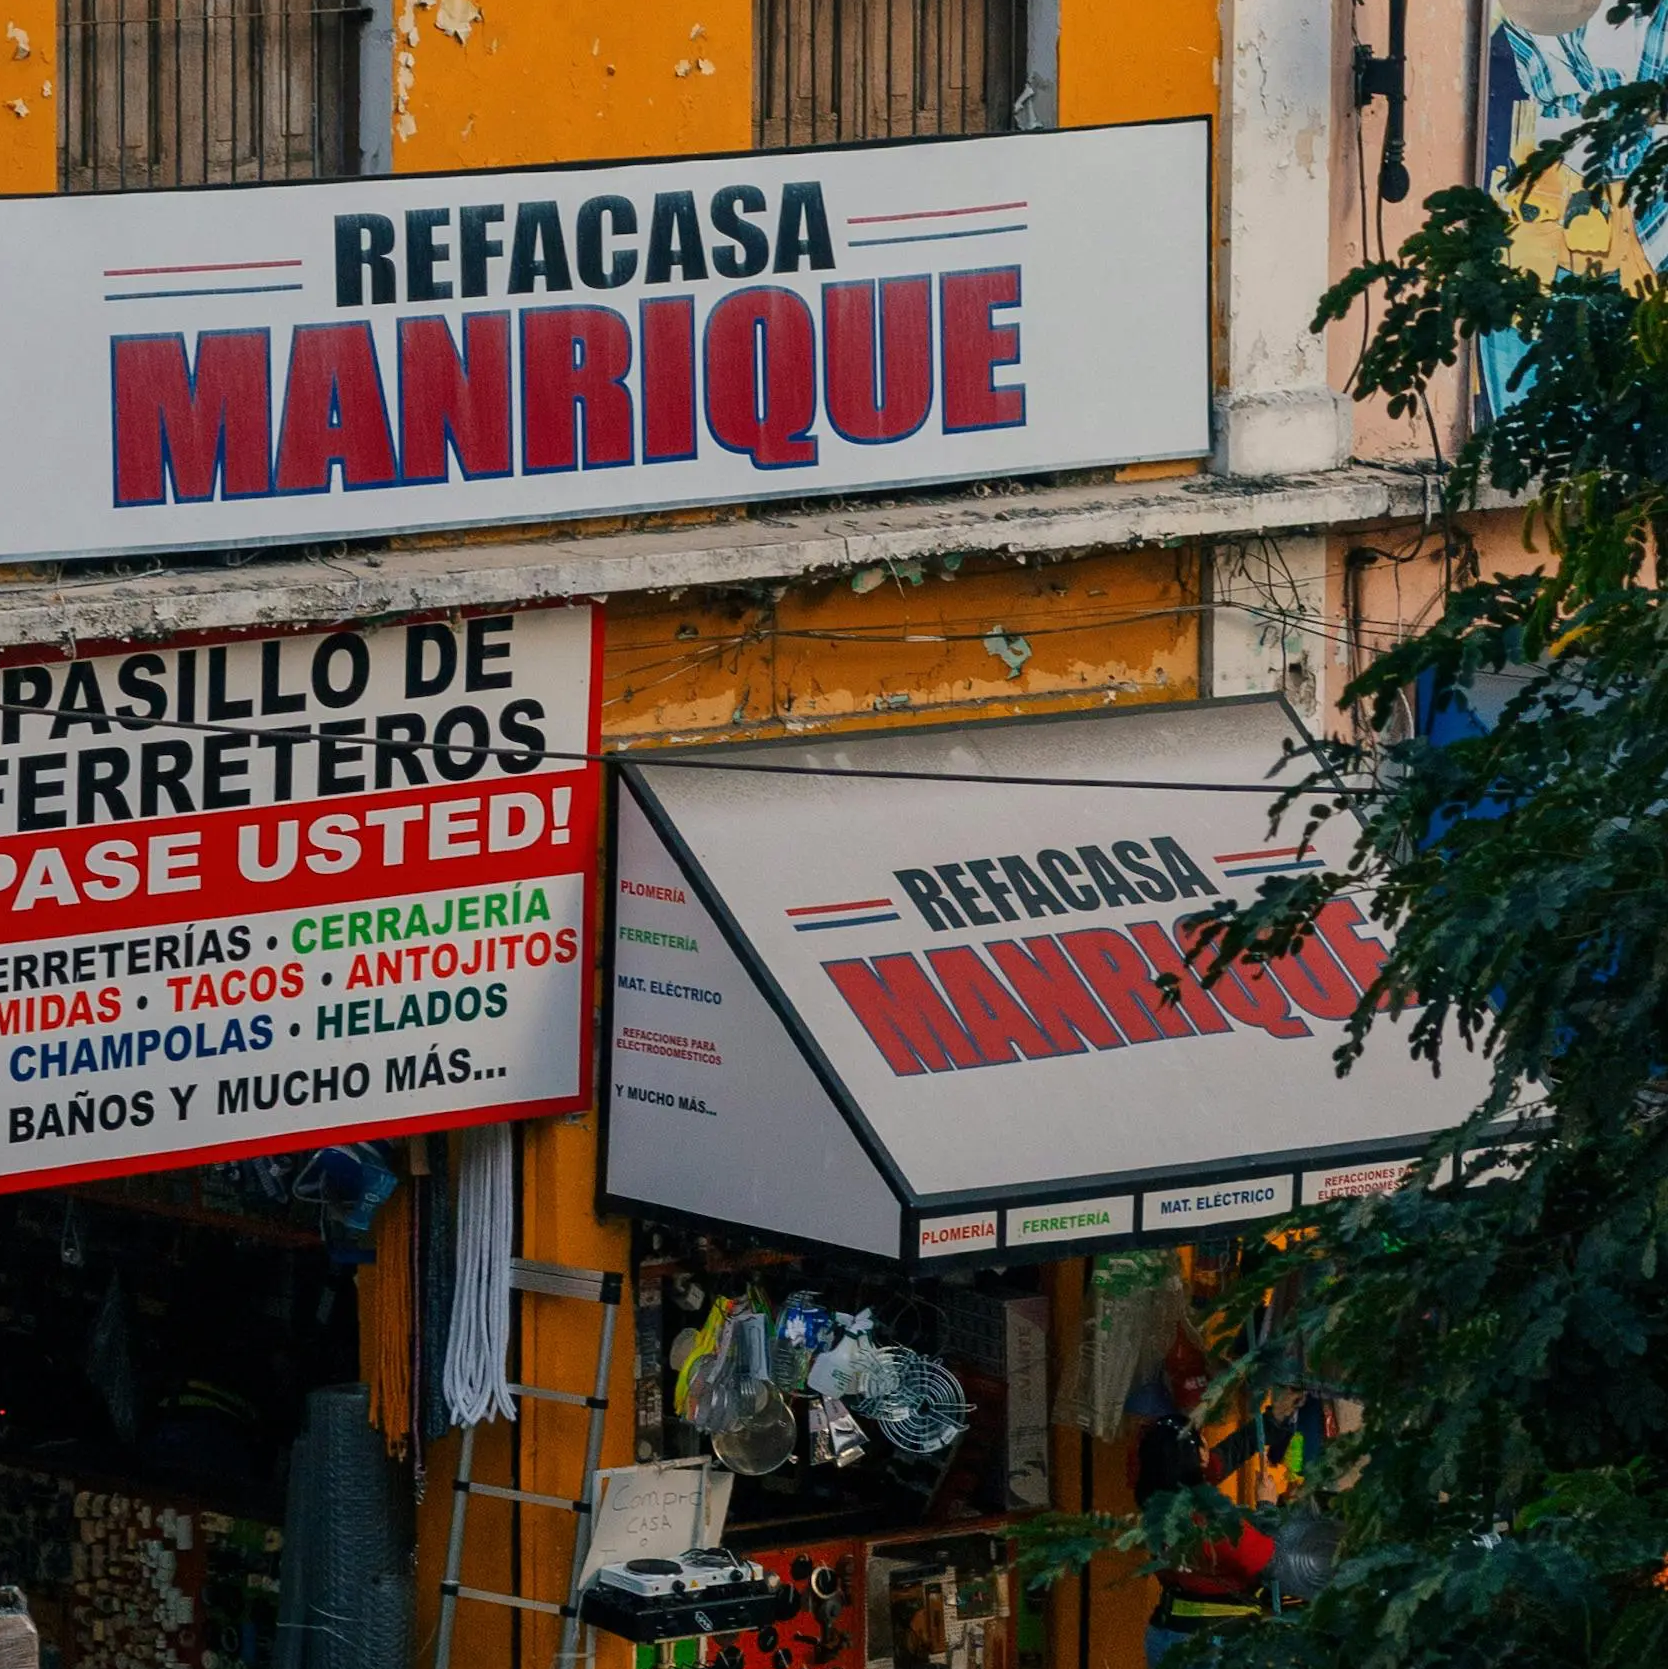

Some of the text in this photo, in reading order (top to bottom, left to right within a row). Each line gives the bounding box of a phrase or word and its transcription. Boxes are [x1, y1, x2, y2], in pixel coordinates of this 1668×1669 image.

[334, 181, 836, 308] REFACASA
[111, 264, 1027, 509] MANRIQUE
[1, 615, 514, 745] PASILLO DE
[236, 787, 573, 883] USTED!
[620, 879, 686, 905] PLOMERÍA
[892, 835, 1221, 932] REFACASA
[291, 886, 551, 955] CERRAJERÍA
[618, 926, 699, 953] FERRETERÍA
[167, 961, 304, 1015] TACOS
[346, 927, 579, 991] ANTOJITOS
[618, 974, 722, 1005] MAT. ELÉCTRICO
[819, 896, 1434, 1077] MANRIQUE
[8, 981, 509, 1083] CHAMPOLAS HELADOS
[623, 1027, 716, 1052] REFACCIONES PARA
[8, 1043, 508, 1145] BAÑOS Y MUCHO MÁS...
[615, 1083, 624, 1097] Y
[627, 1086, 674, 1107] MUCHO
[1160, 1187, 1275, 1215] MAT. ELÉCTRICO
[1324, 1167, 1396, 1188] REFACCIONES
[921, 1220, 996, 1245] PLOMERÍA
[1022, 1211, 1111, 1234] FERRETERÍA
[626, 1514, 672, 1534] CASA
